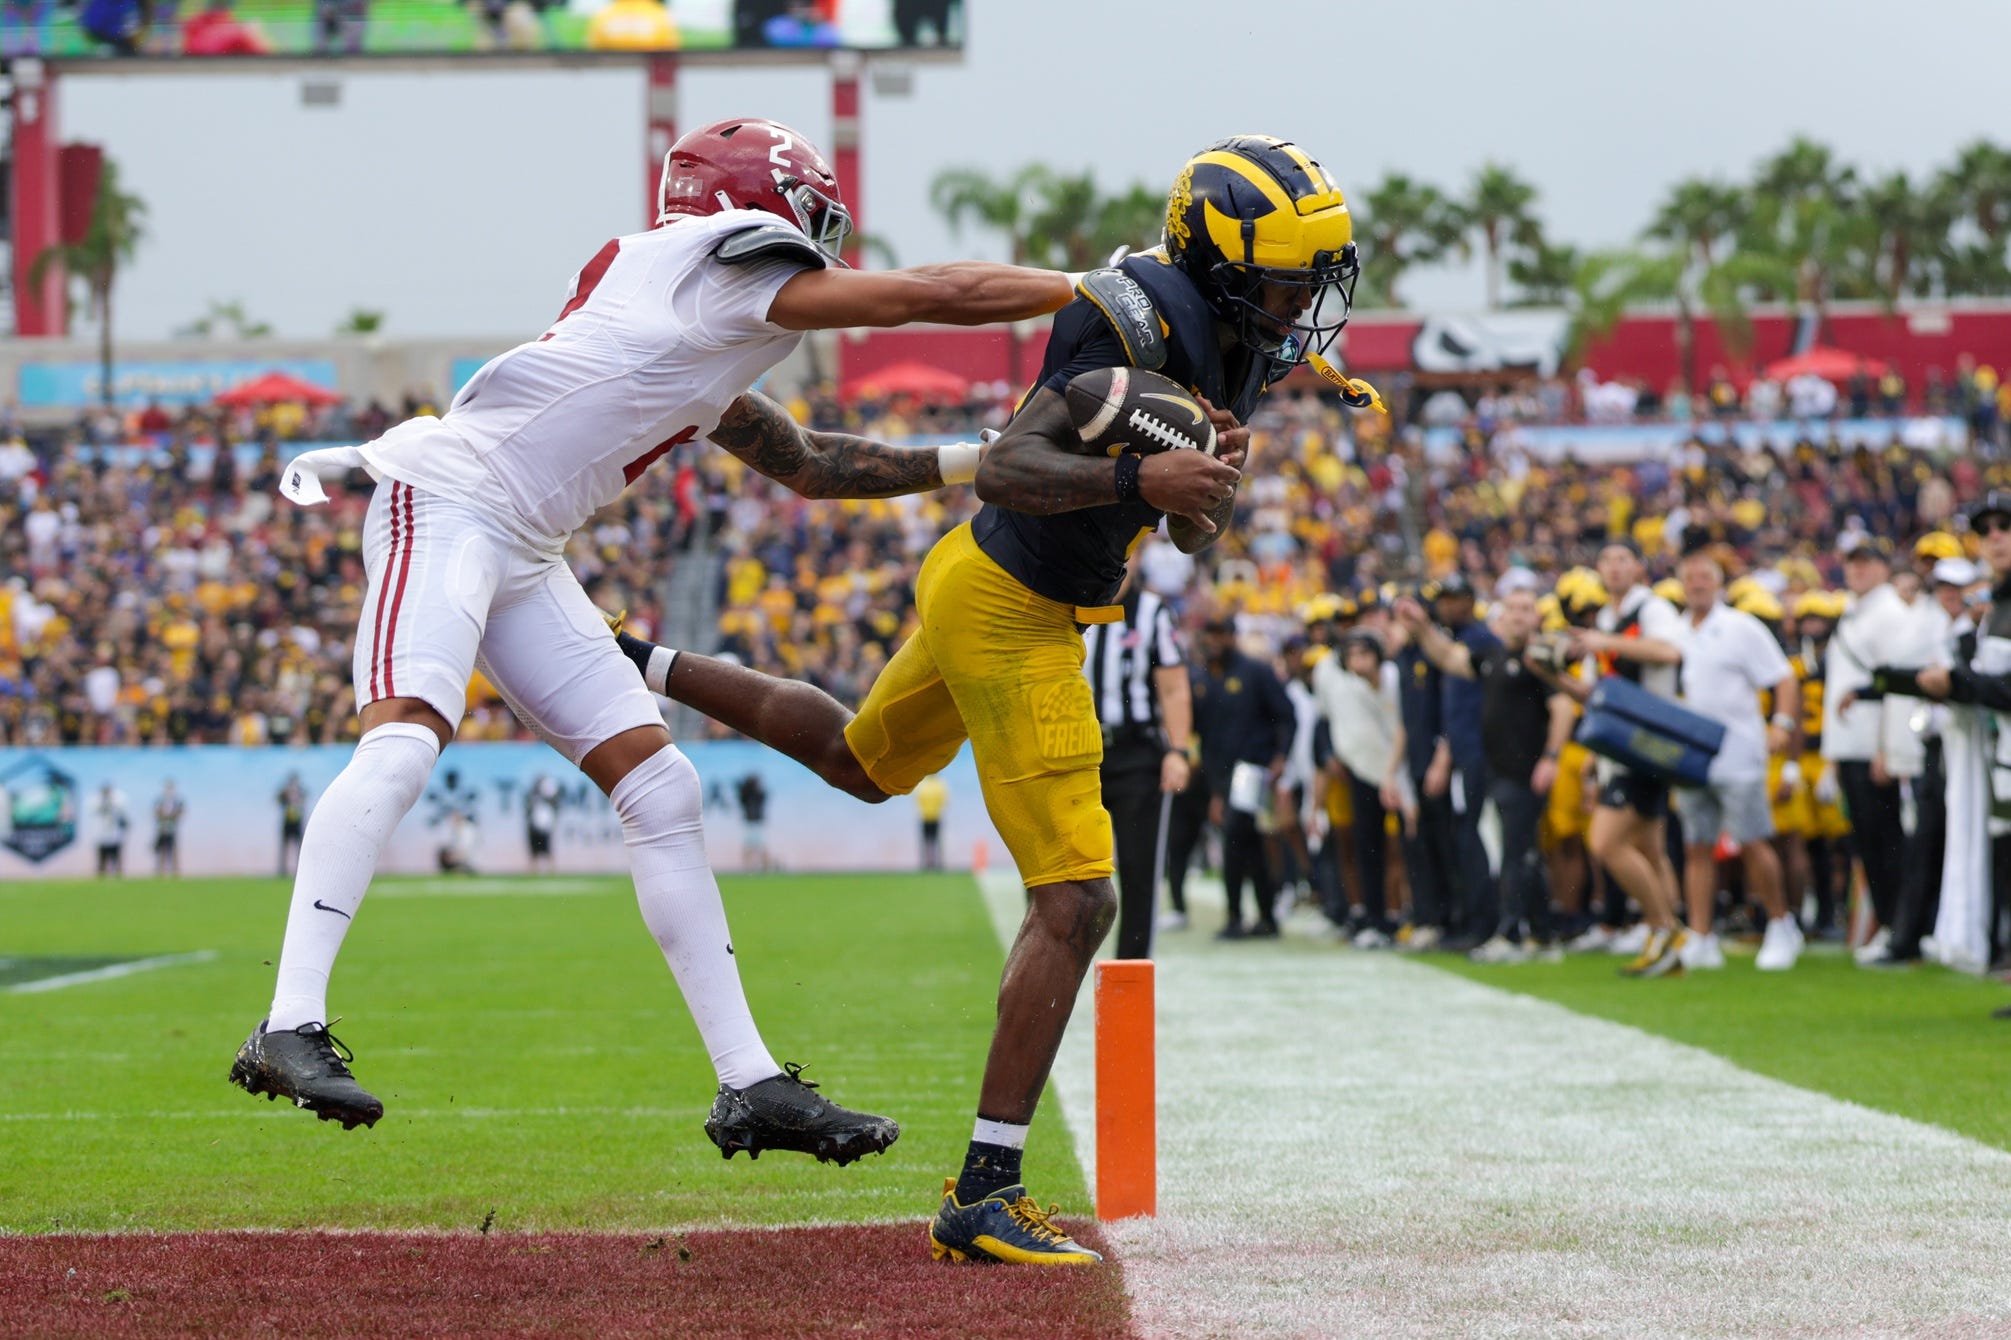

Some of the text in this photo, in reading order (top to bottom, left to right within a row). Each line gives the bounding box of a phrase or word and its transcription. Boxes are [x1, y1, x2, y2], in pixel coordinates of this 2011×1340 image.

[768, 129, 793, 169] 2
[1116, 276, 1153, 311] PRO
[1115, 292, 1155, 348] GEAR
